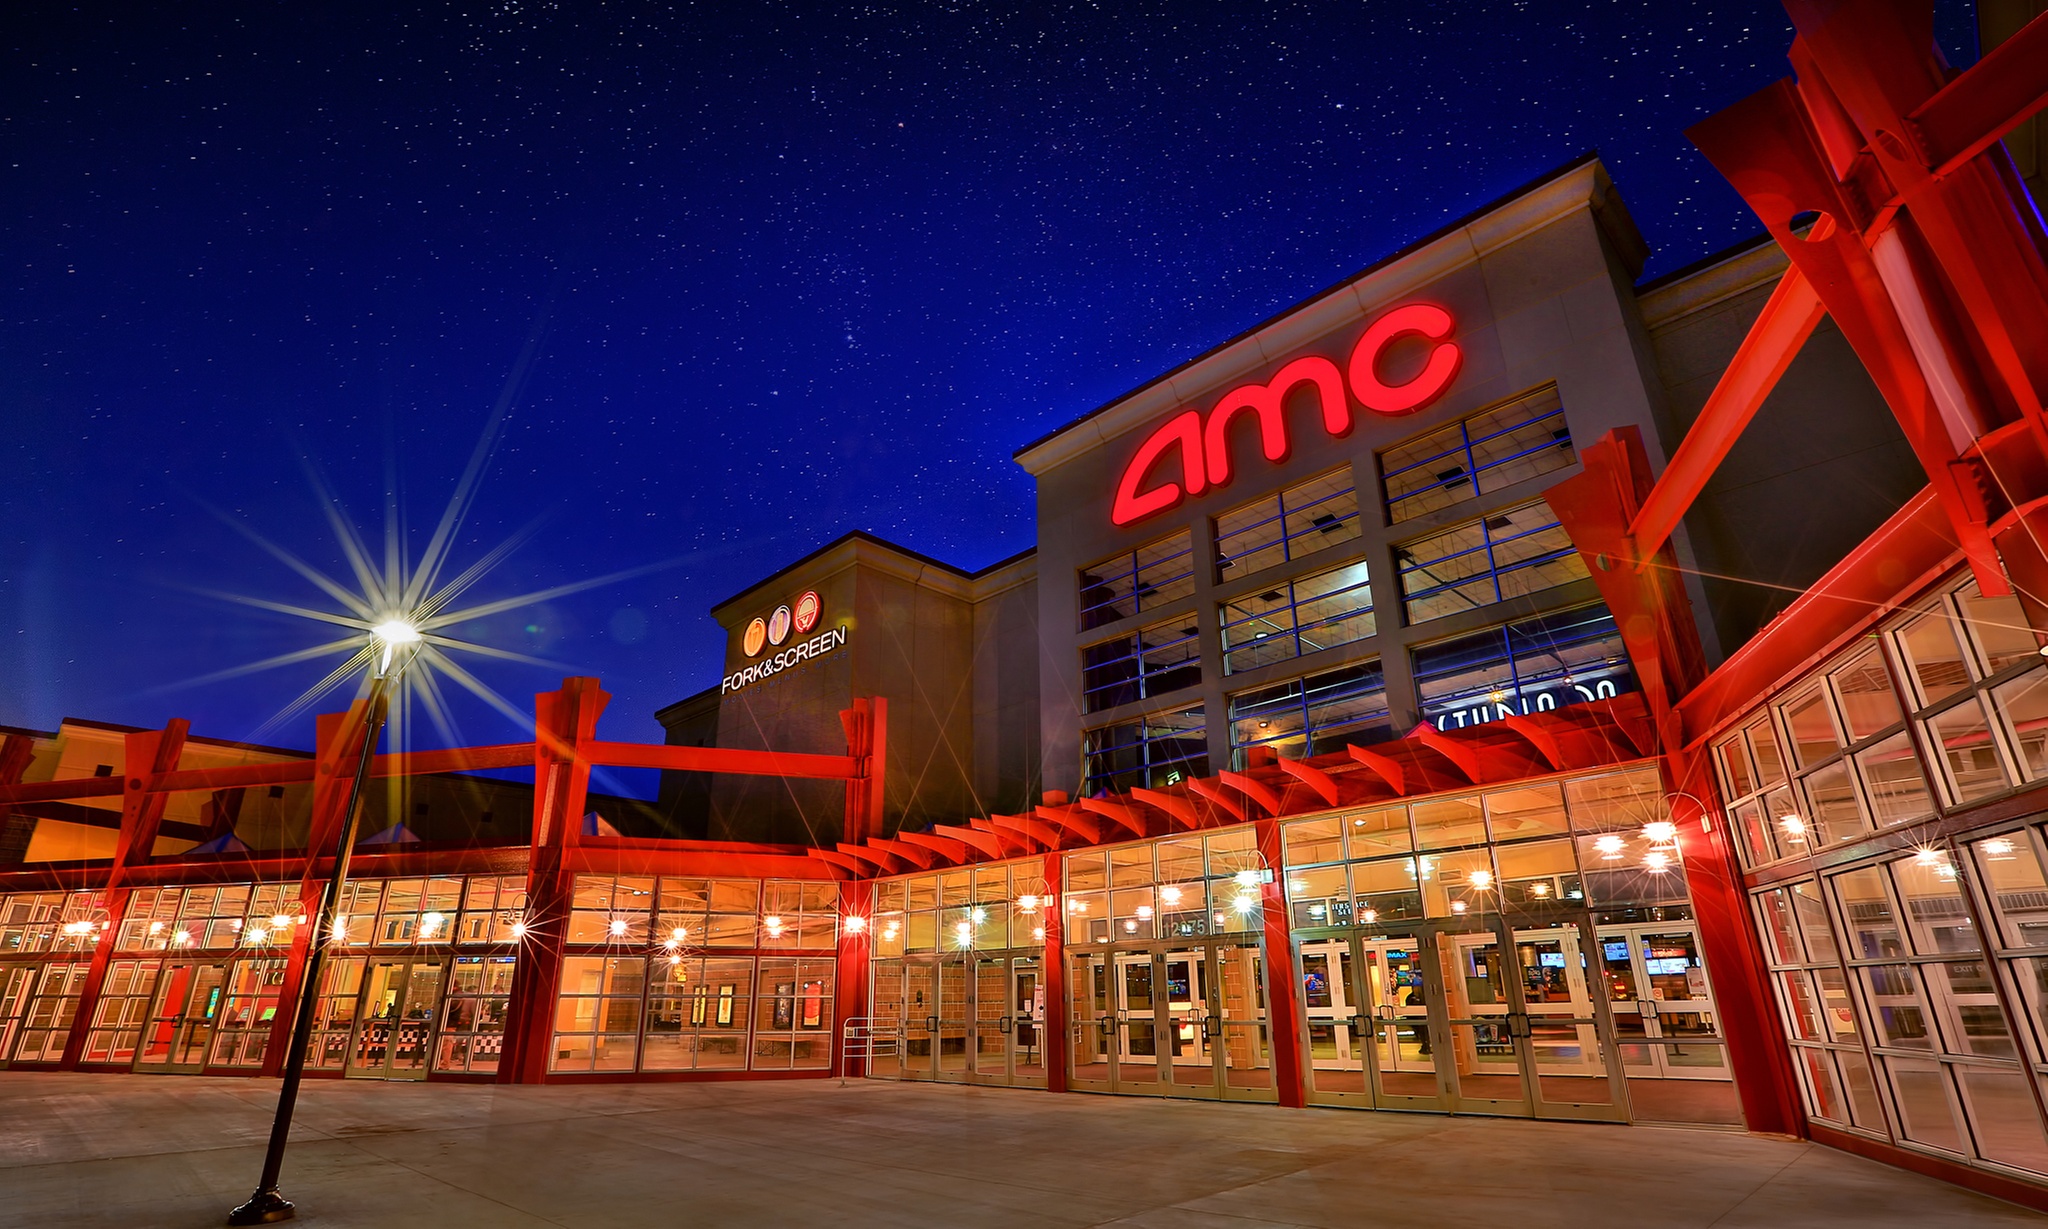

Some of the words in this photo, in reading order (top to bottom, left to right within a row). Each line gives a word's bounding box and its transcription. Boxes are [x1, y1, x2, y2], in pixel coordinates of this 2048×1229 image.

[721, 625, 847, 695] FORK&SCREEN
[769, 667, 807, 688] MENUS
[815, 651, 848, 669] MORE
